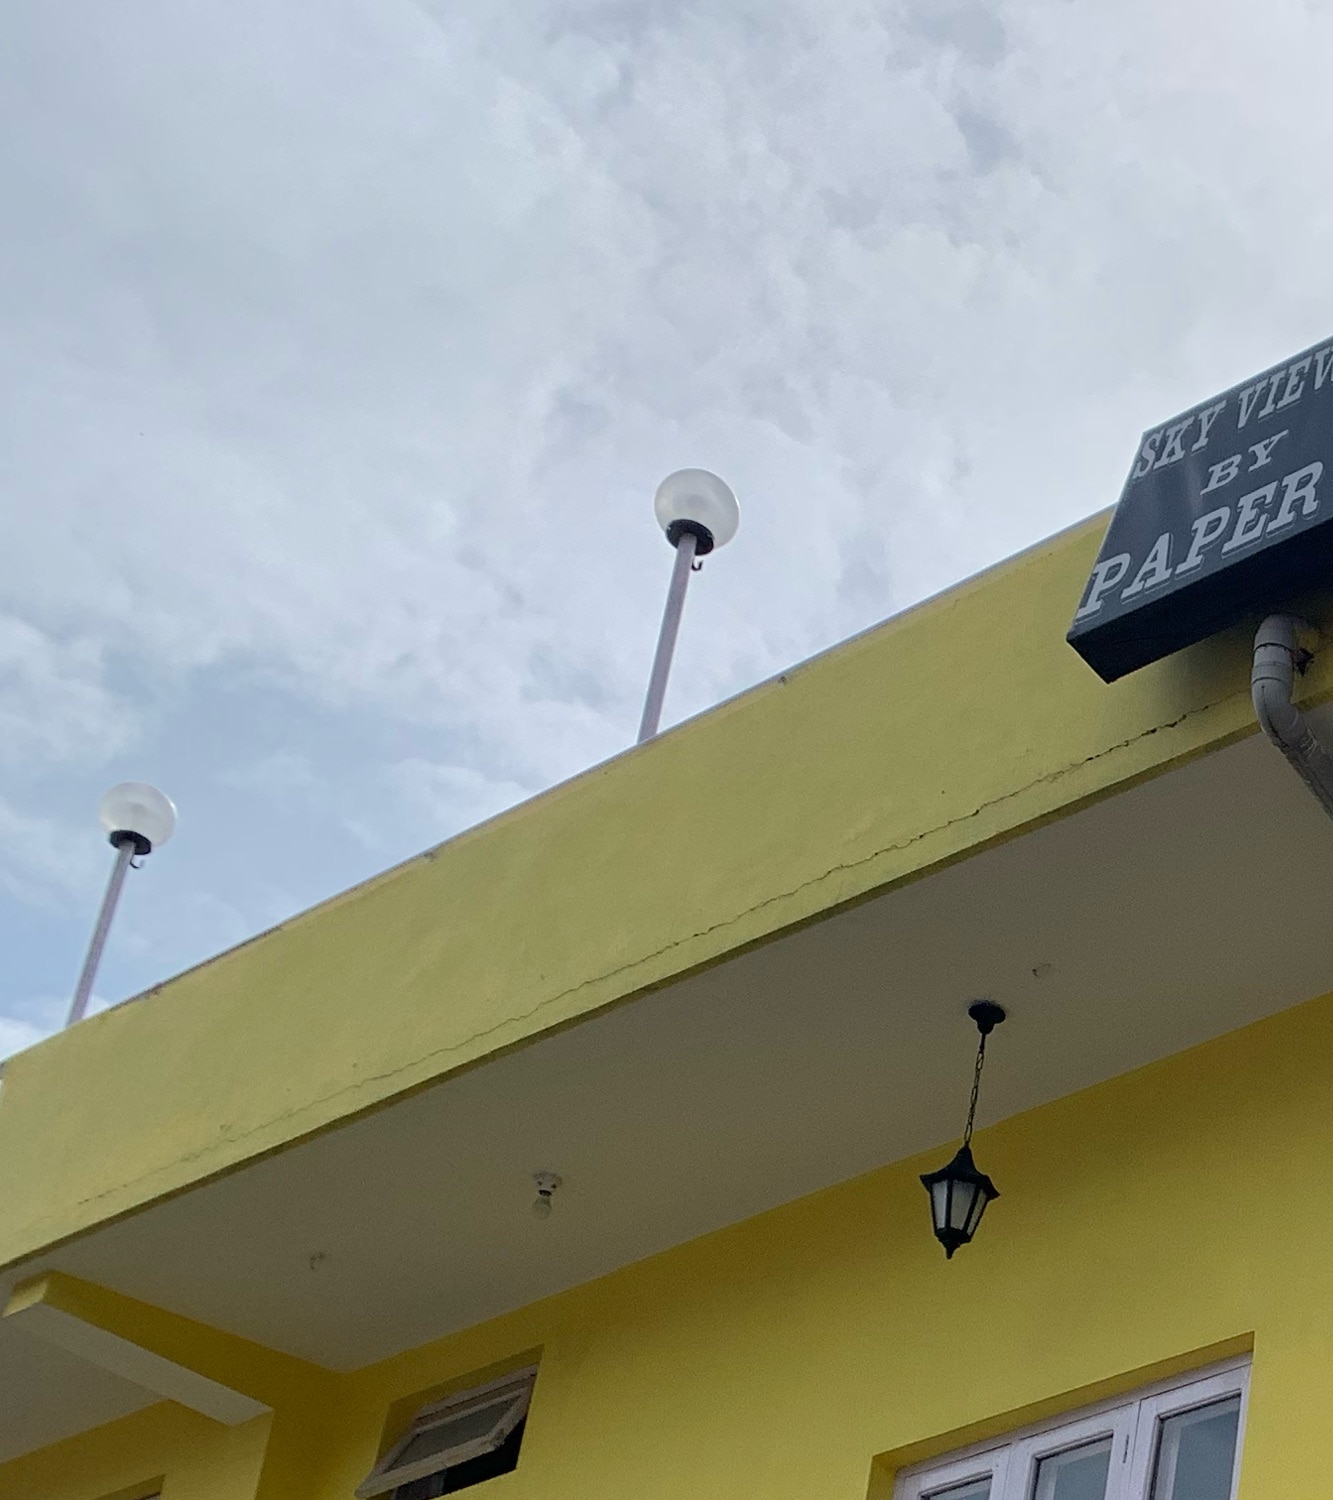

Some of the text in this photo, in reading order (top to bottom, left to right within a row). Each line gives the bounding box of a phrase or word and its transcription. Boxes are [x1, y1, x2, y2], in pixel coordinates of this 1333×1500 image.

[1132, 402, 1228, 480] SKY
[1200, 430, 1289, 496] BY
[1075, 461, 1325, 621] PAPER
